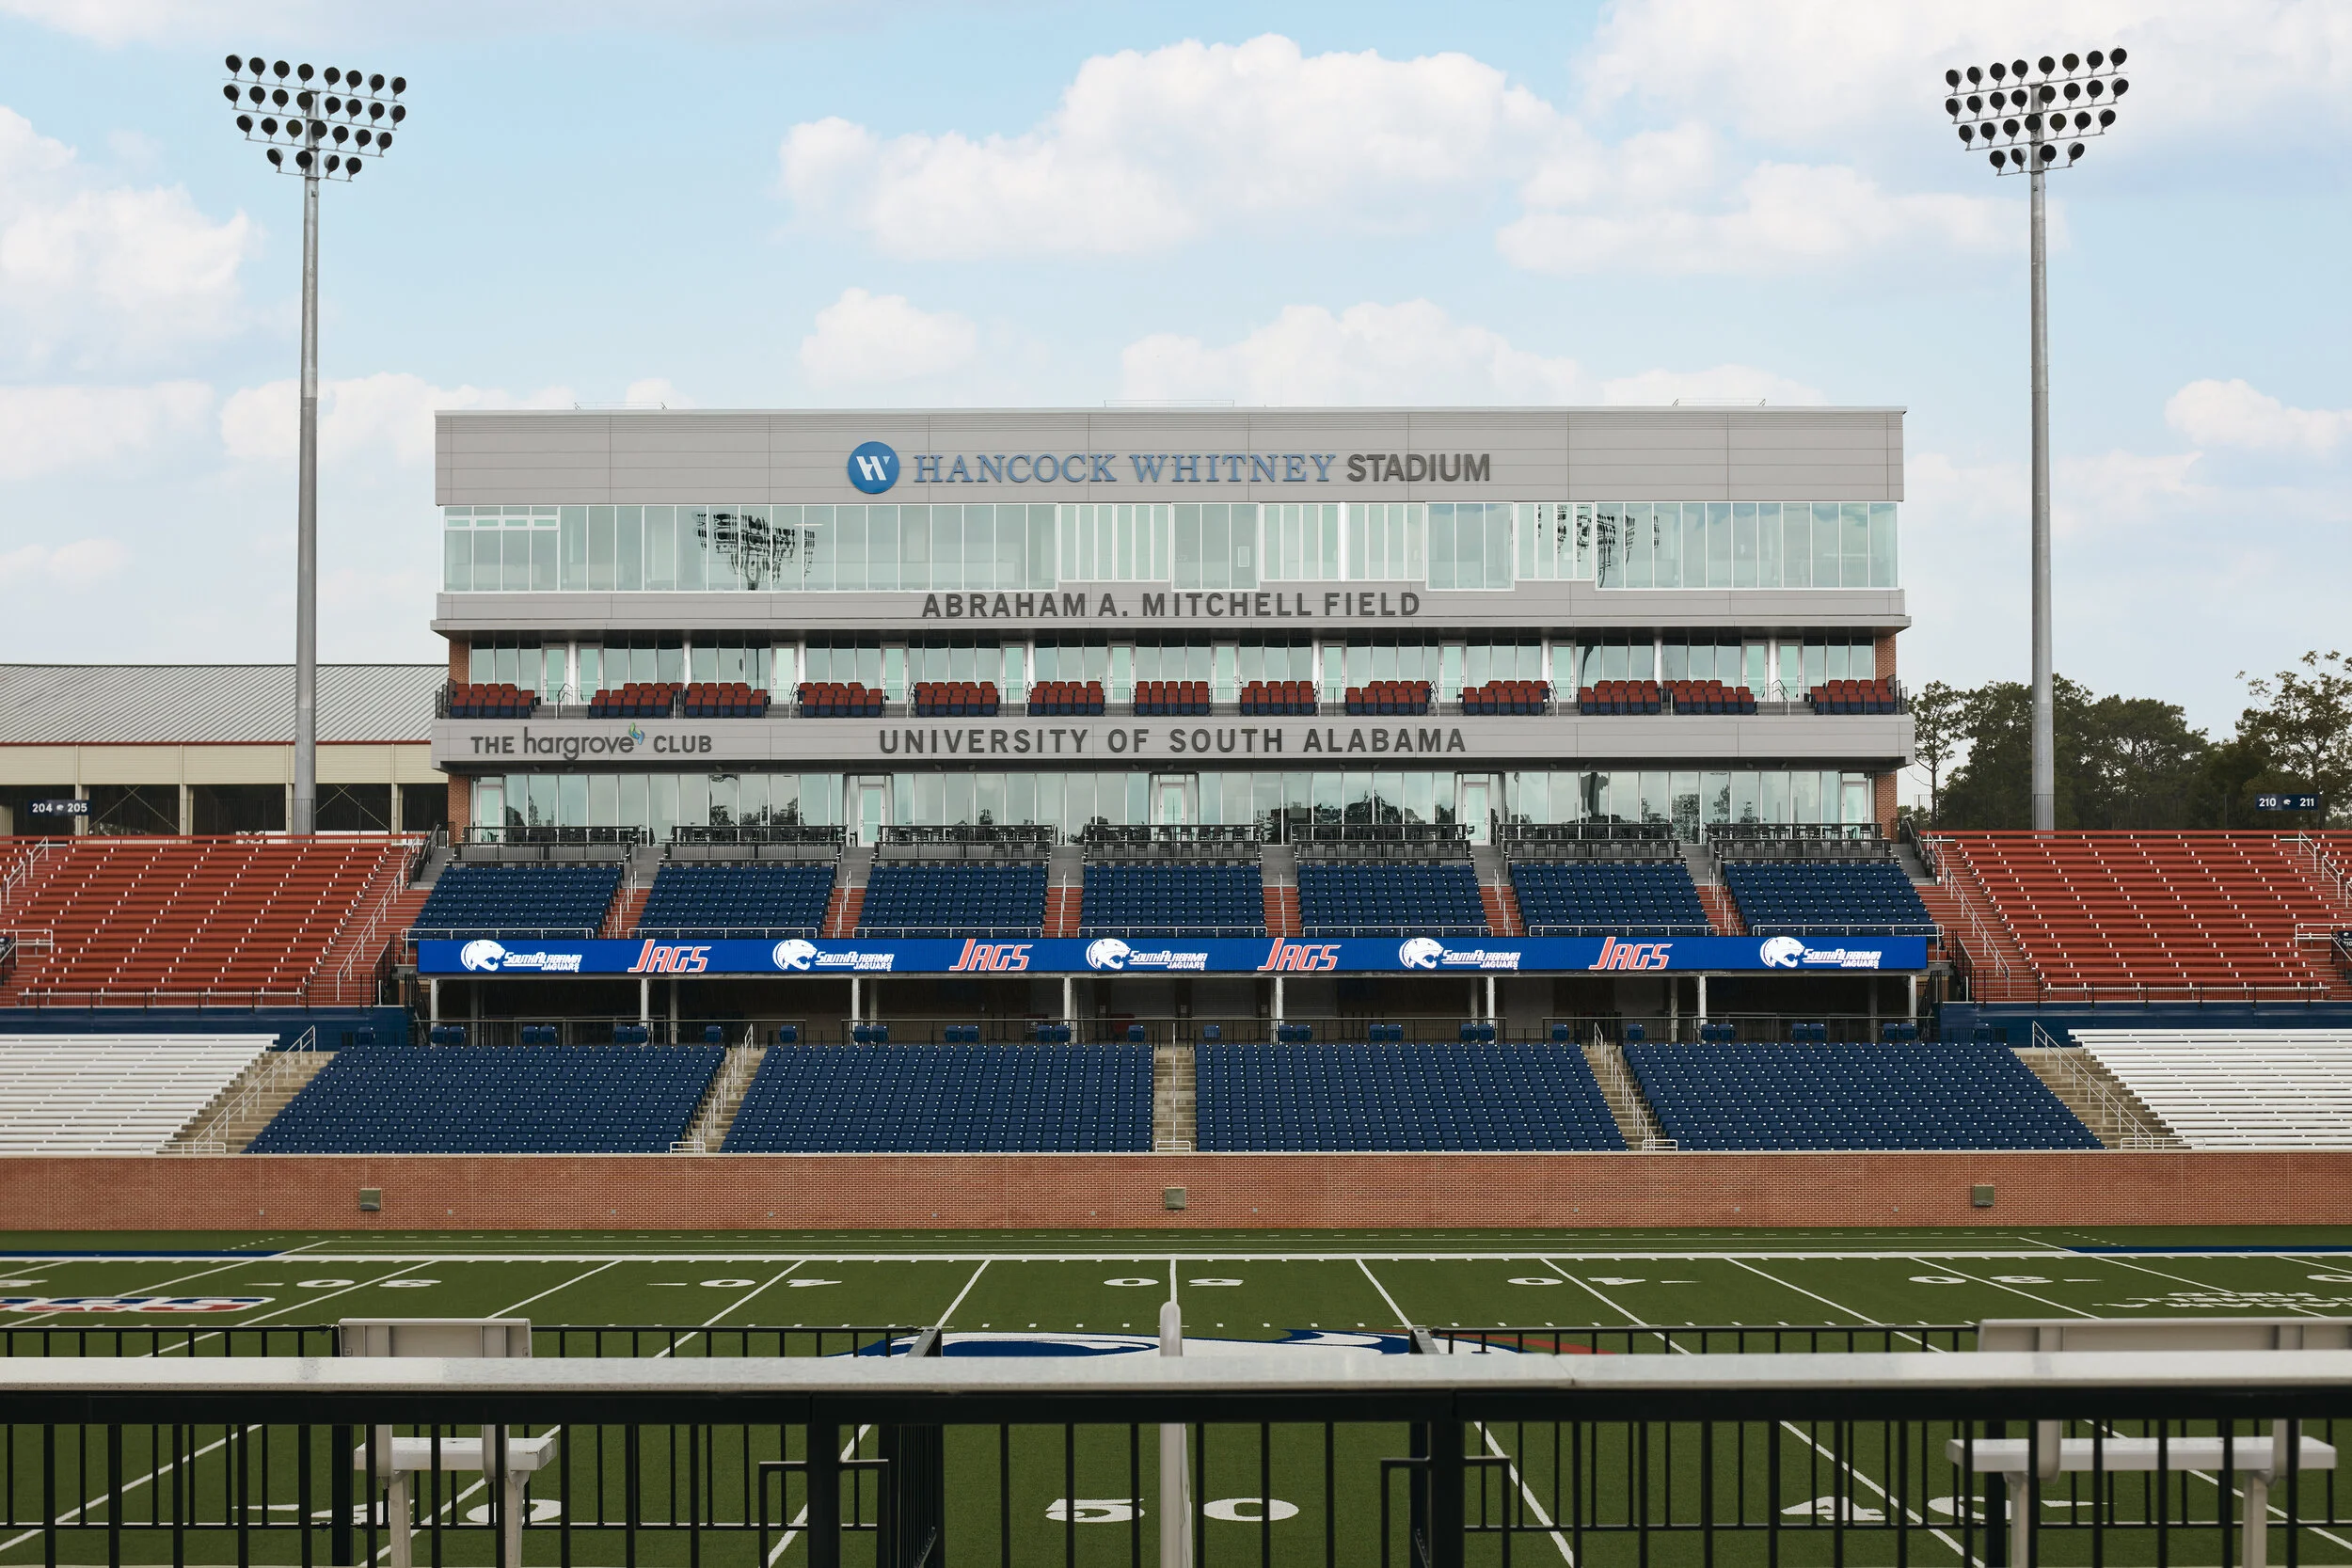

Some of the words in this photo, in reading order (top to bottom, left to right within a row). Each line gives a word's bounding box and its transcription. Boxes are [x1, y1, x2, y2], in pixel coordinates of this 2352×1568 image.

[913, 453, 1117, 483] HANCOCK
[1128, 453, 1336, 483] WHITNEY
[1346, 453, 1491, 483] STADIUM
[921, 593, 1088, 618] ABRAHAM
[1097, 593, 1129, 617] A.
[1142, 593, 1315, 617] MITCHELL
[1324, 593, 1421, 616] FIELD
[470, 736, 515, 754] THE
[524, 726, 635, 761] hargrove
[653, 735, 712, 753] CLUB
[880, 729, 1089, 754] UNIVERSITY
[1107, 729, 1150, 753] OF
[1168, 728, 1283, 753] SOUTH
[1303, 728, 1467, 753] ALABAMA
[32, 803, 53, 813] 204
[67, 802, 87, 813] 205
[2259, 798, 2277, 807] 210
[2299, 798, 2314, 807] 211
[628, 939, 712, 973] JAGS
[948, 938, 1034, 971] JAGS
[1167, 961, 1205, 970] JAGUARS
[1257, 938, 1342, 971] JAGS
[1480, 960, 1518, 969] JAGUARS
[1588, 936, 1674, 970] JAGS
[1840, 959, 1880, 969] JAGUARS
[541, 963, 580, 972] JAGUARS
[853, 962, 892, 971] JAGUARS
